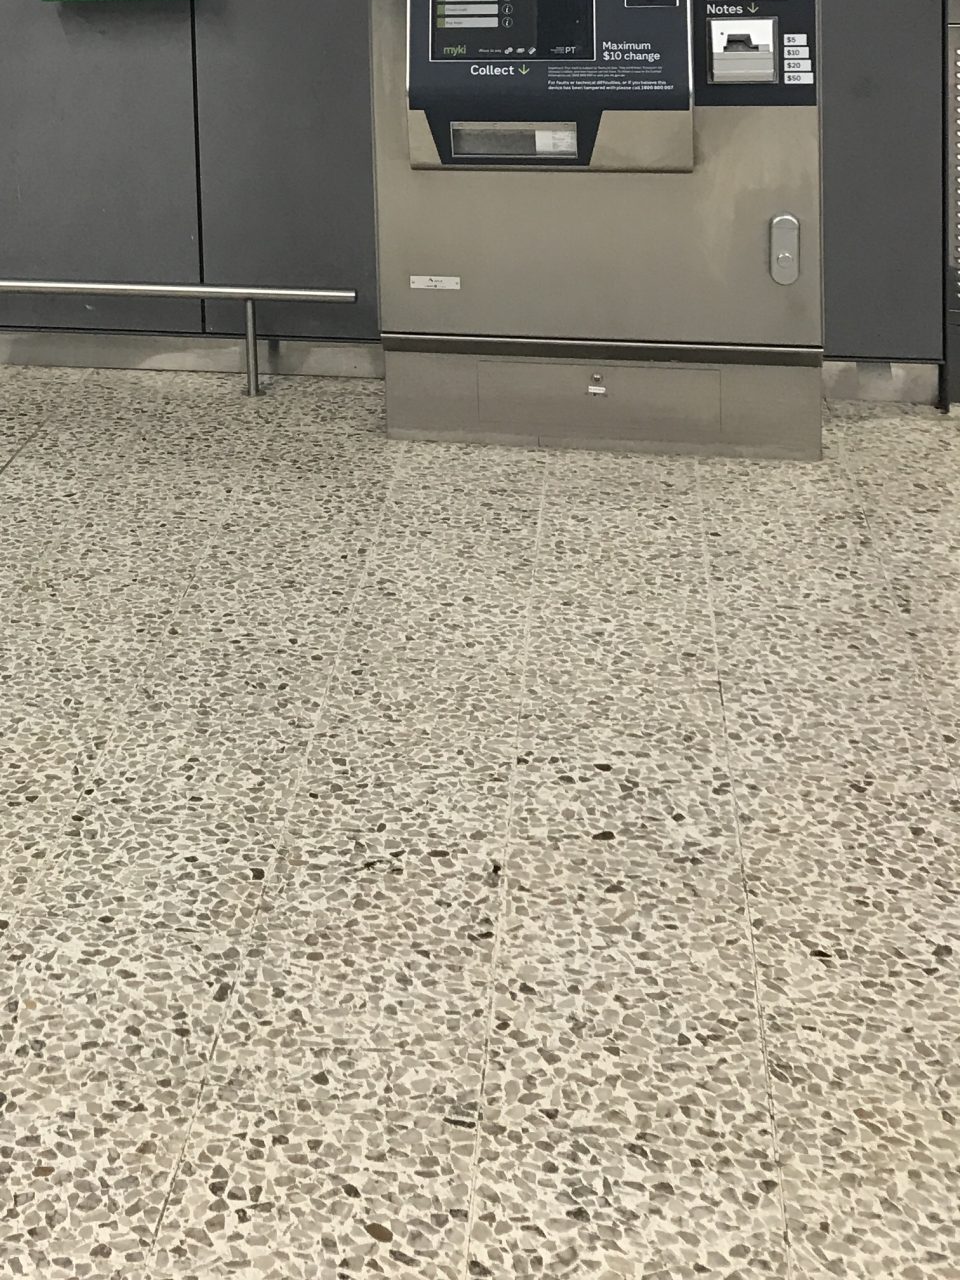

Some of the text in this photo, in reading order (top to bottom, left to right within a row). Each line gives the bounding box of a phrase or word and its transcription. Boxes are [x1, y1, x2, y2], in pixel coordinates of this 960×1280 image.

[706, 4, 744, 15] Notes
[786, 36, 797, 44] $5
[565, 46, 576, 54] PT
[602, 40, 652, 51] Maximum
[444, 45, 466, 57] myki
[786, 49, 800, 57] $10
[602, 50, 661, 62] $10 change
[470, 64, 515, 76] Collect
[786, 62, 801, 70] $20
[786, 74, 802, 82] $50
